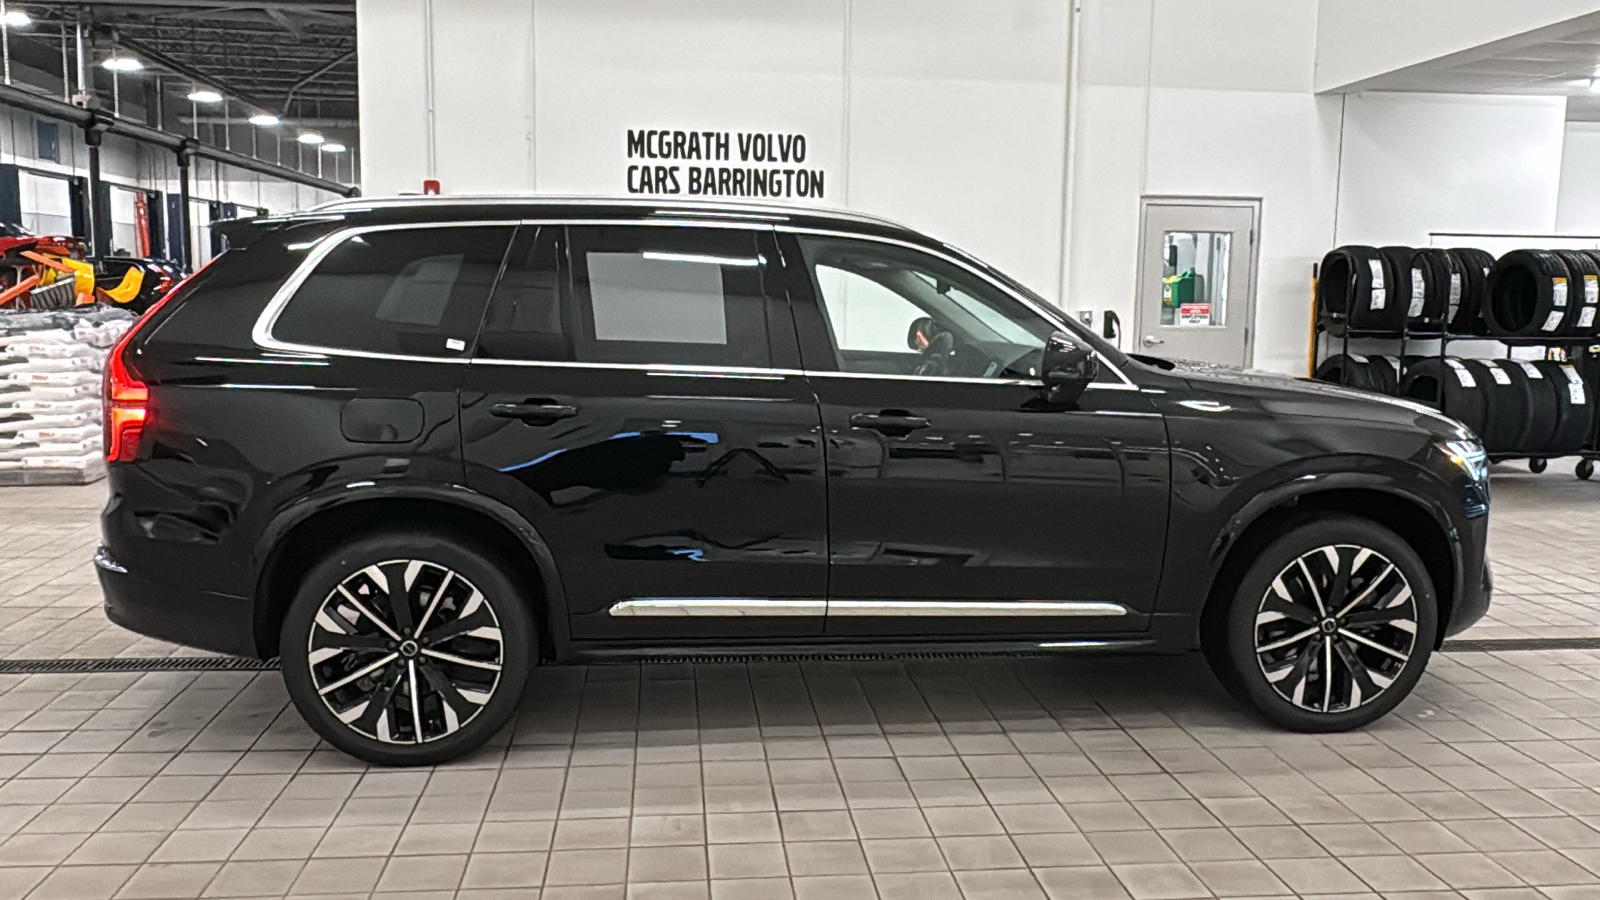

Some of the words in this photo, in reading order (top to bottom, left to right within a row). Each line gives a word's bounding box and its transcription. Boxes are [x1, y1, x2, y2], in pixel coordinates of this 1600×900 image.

[627, 129, 730, 161] MCGRATH
[737, 132, 806, 164] VOLVO
[627, 165, 681, 194] CARS
[688, 166, 824, 198] BARRINGTON
